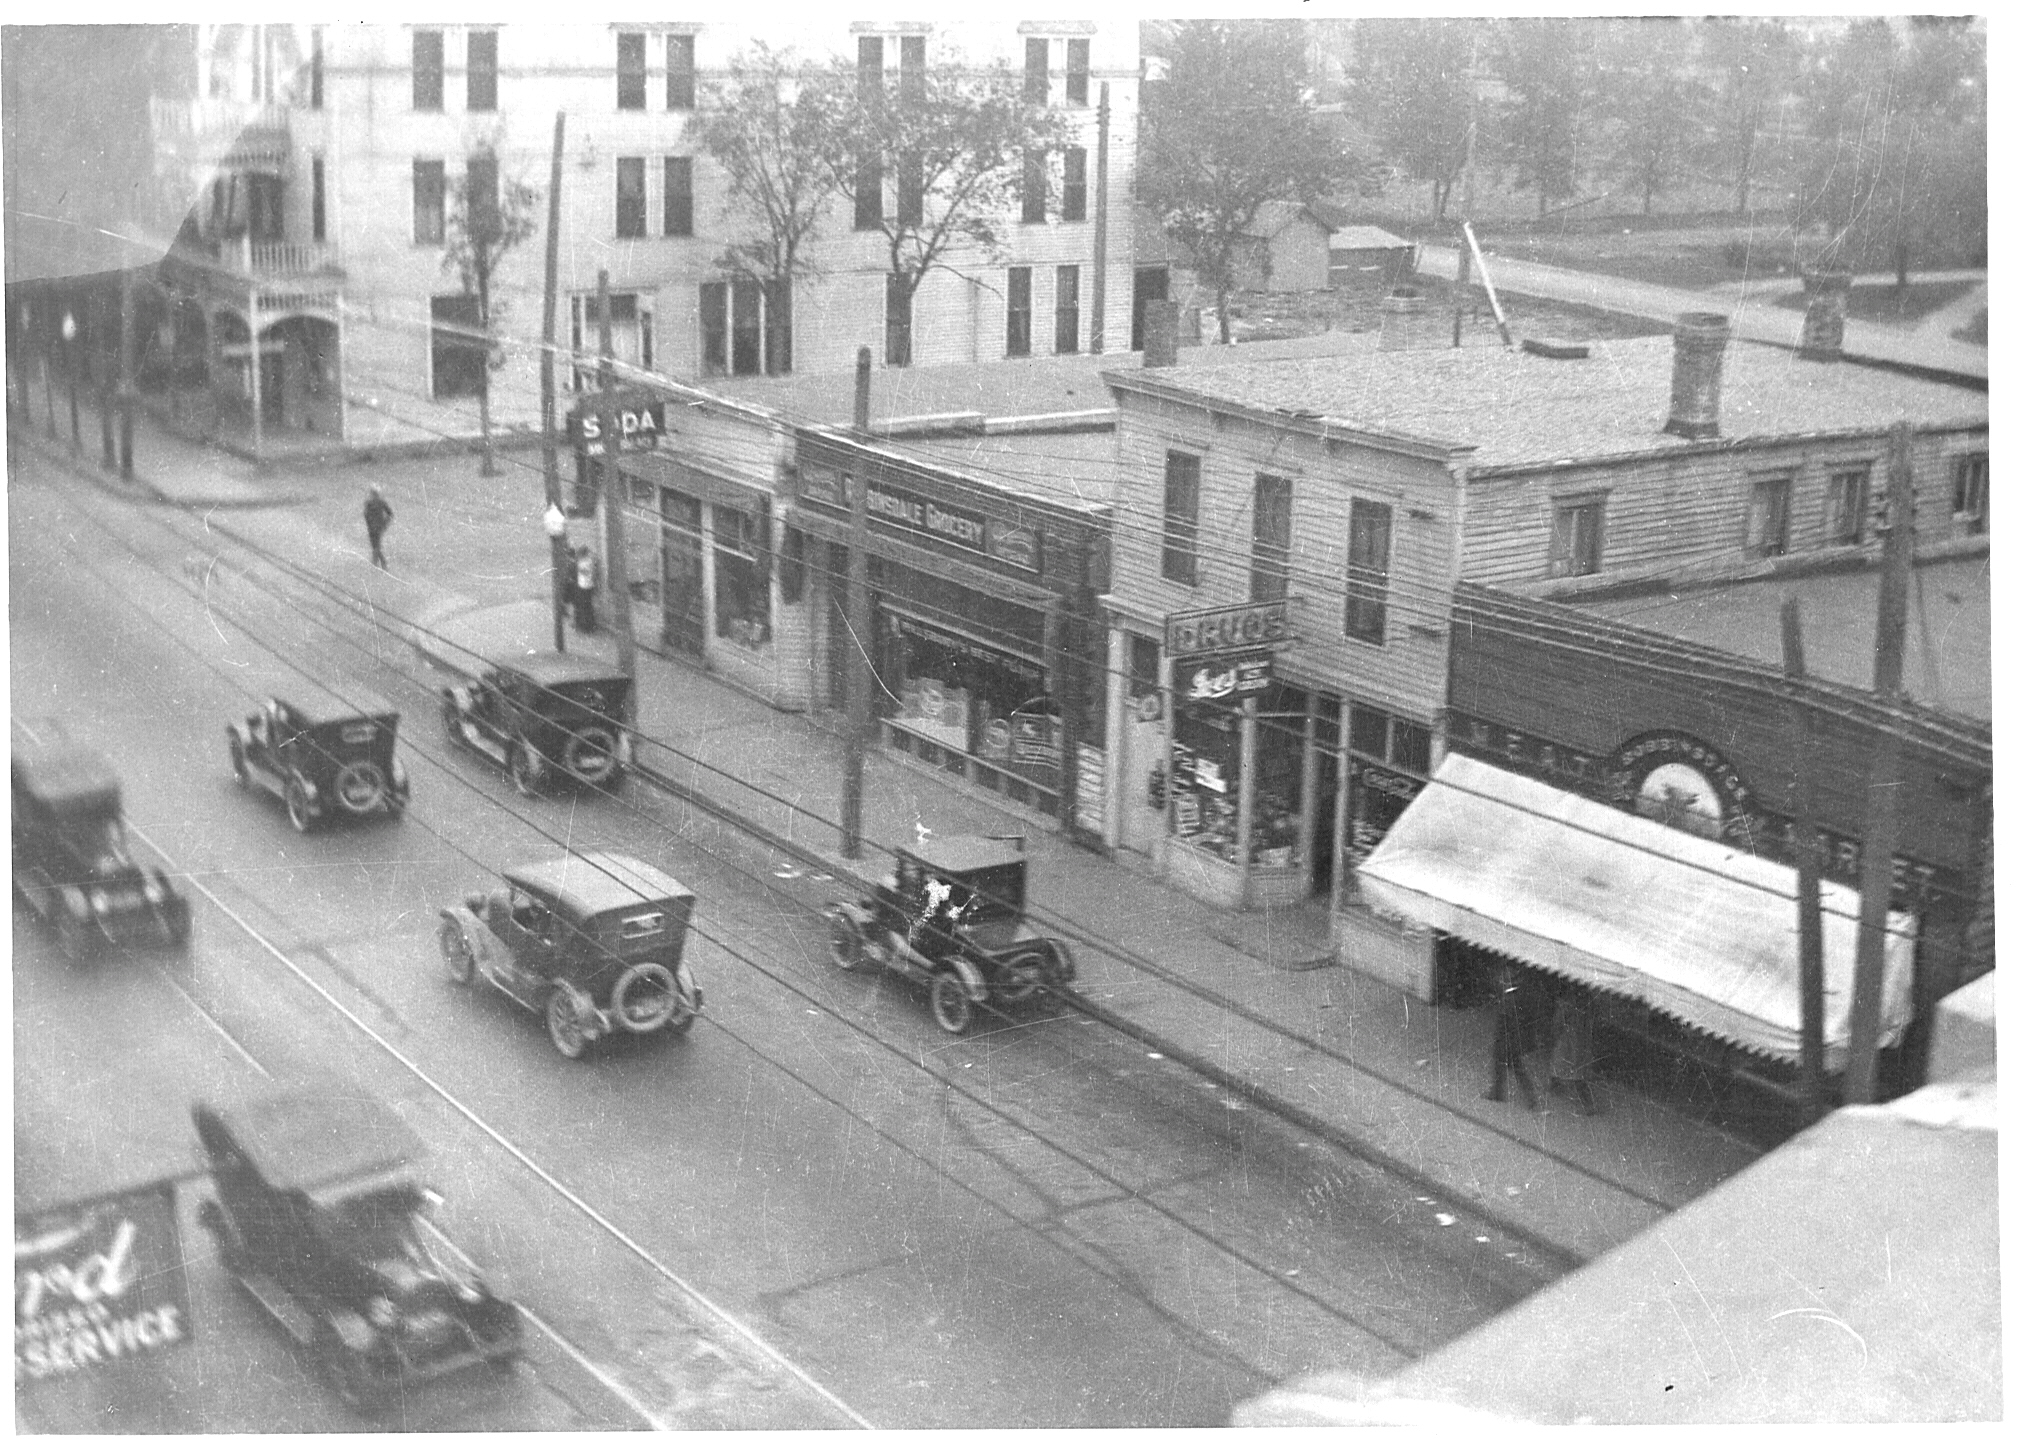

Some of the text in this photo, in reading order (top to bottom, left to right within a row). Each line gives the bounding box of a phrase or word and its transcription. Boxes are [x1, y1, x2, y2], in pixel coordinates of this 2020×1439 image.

[582, 409, 656, 439] SDA
[925, 503, 984, 543] GROCERY
[1172, 610, 1284, 652] DRUGS
[22, 1304, 182, 1378] SERVICE
